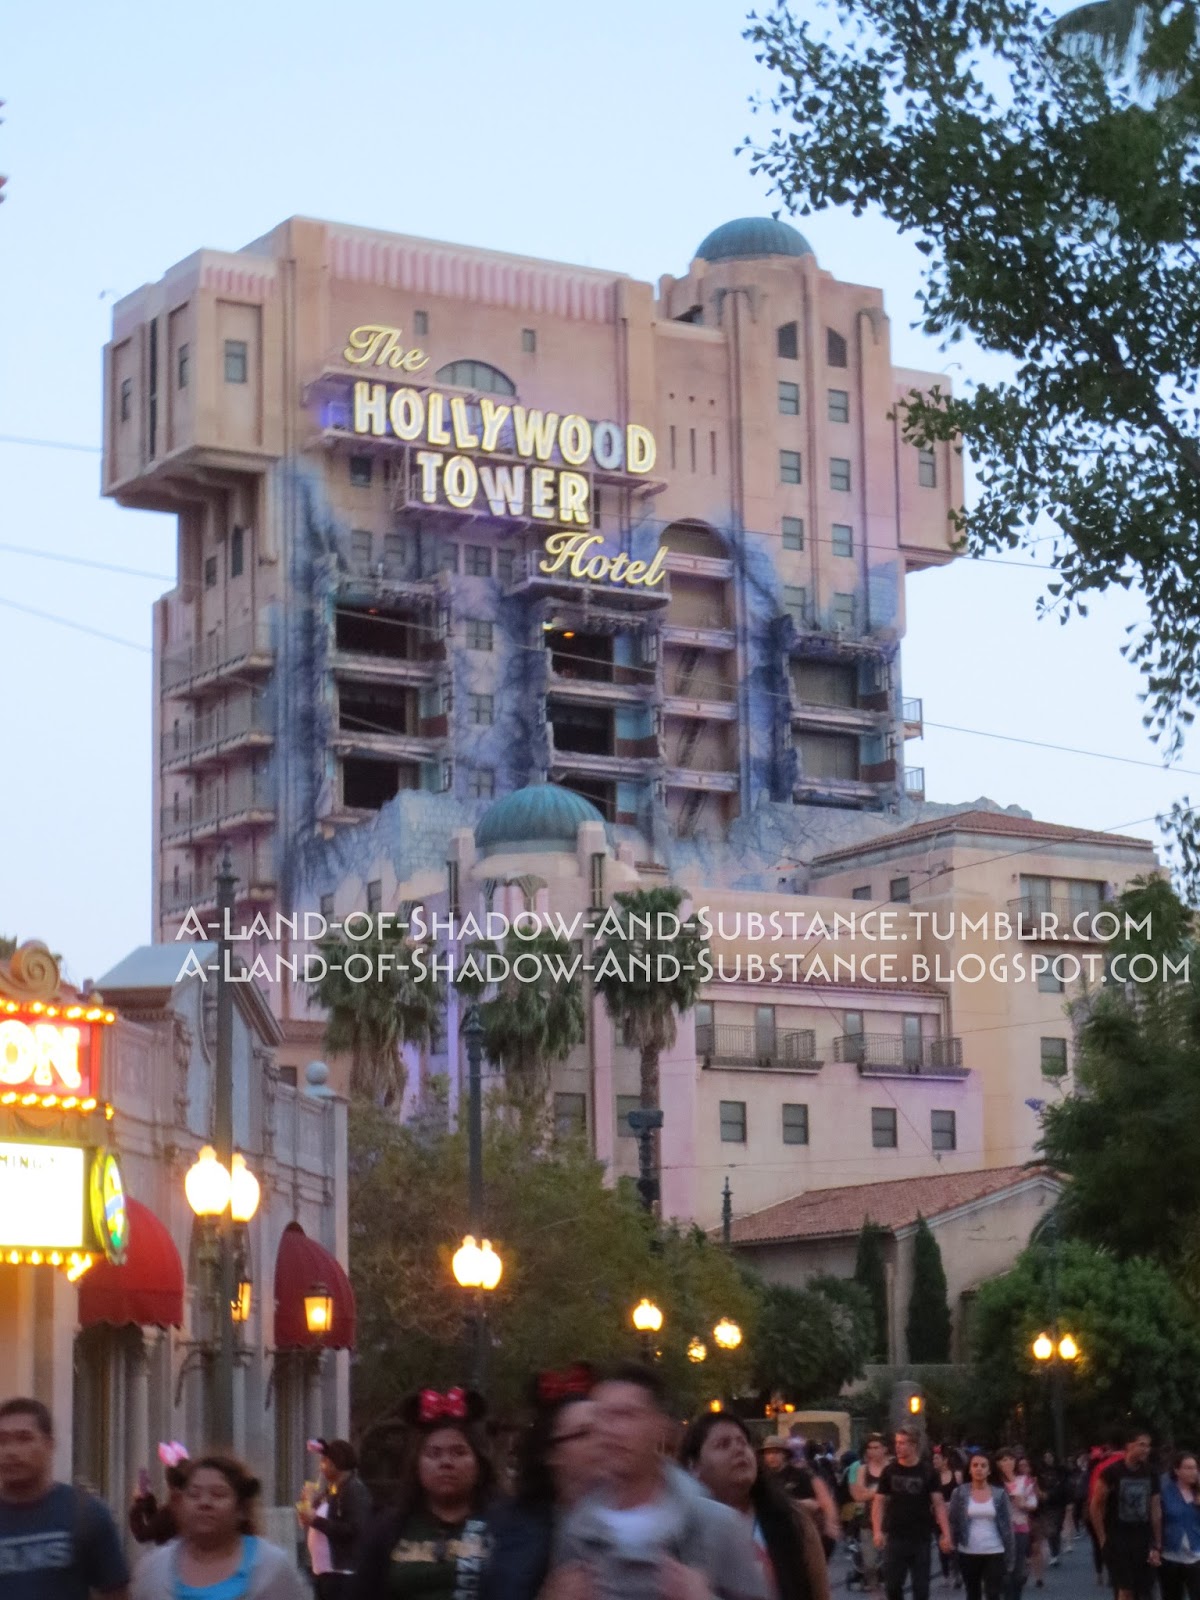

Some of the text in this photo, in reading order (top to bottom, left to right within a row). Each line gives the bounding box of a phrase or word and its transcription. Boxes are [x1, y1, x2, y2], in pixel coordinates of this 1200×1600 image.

[344, 324, 430, 371] The
[353, 380, 657, 474] HOLLYWOOD
[416, 451, 590, 524] TOWER
[539, 531, 669, 587] Hotel
